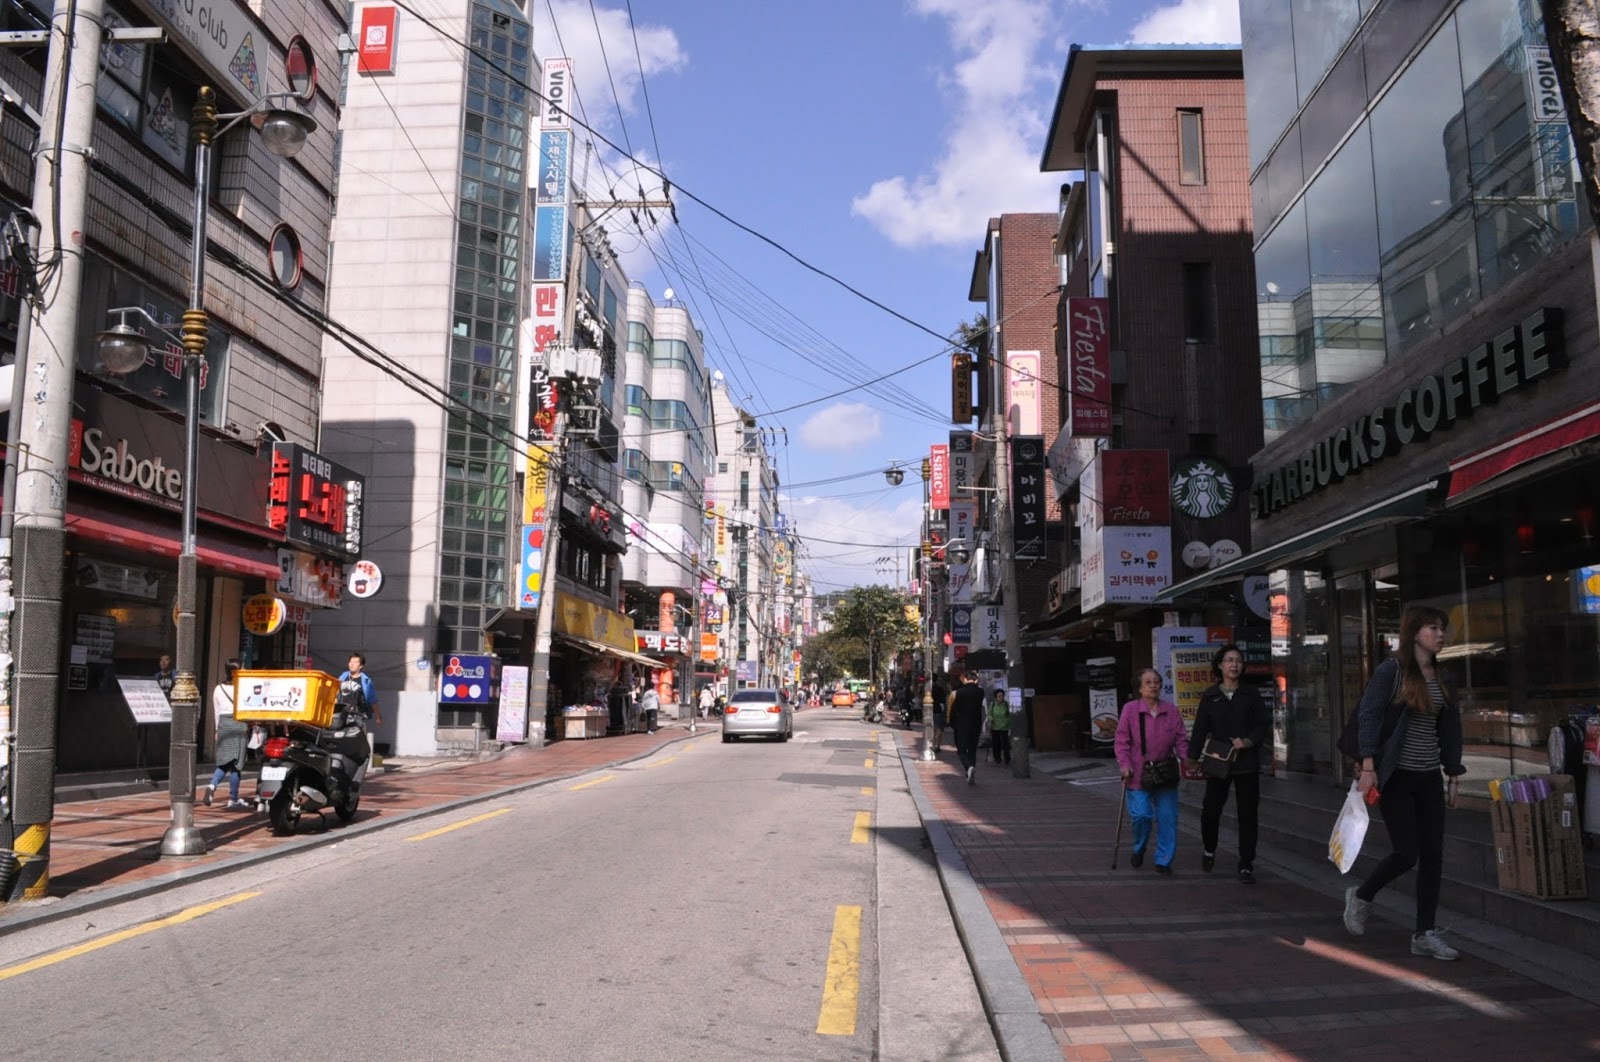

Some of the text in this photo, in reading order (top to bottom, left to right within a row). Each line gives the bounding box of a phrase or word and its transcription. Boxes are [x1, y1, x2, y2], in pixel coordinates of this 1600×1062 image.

[198, 6, 228, 50] club
[547, 61, 567, 70] cafe
[548, 70, 564, 124] VIOLET
[534, 286, 558, 353] 만화
[1074, 305, 1106, 393] Fiesta
[1076, 408, 1108, 418] 피에스타
[1249, 307, 1551, 520] STARBUCKS COFFEE
[82, 473, 97, 486] THE
[98, 478, 132, 496] ORIGINAL
[955, 456, 967, 493] 미용실
[1020, 474, 1037, 525] 아비꼬
[1109, 505, 1150, 521] Fiesta
[1109, 575, 1168, 586] 김치떡볶이
[245, 606, 278, 622] 노래방
[707, 610, 721, 620] 24
[986, 607, 1002, 648] 미용실
